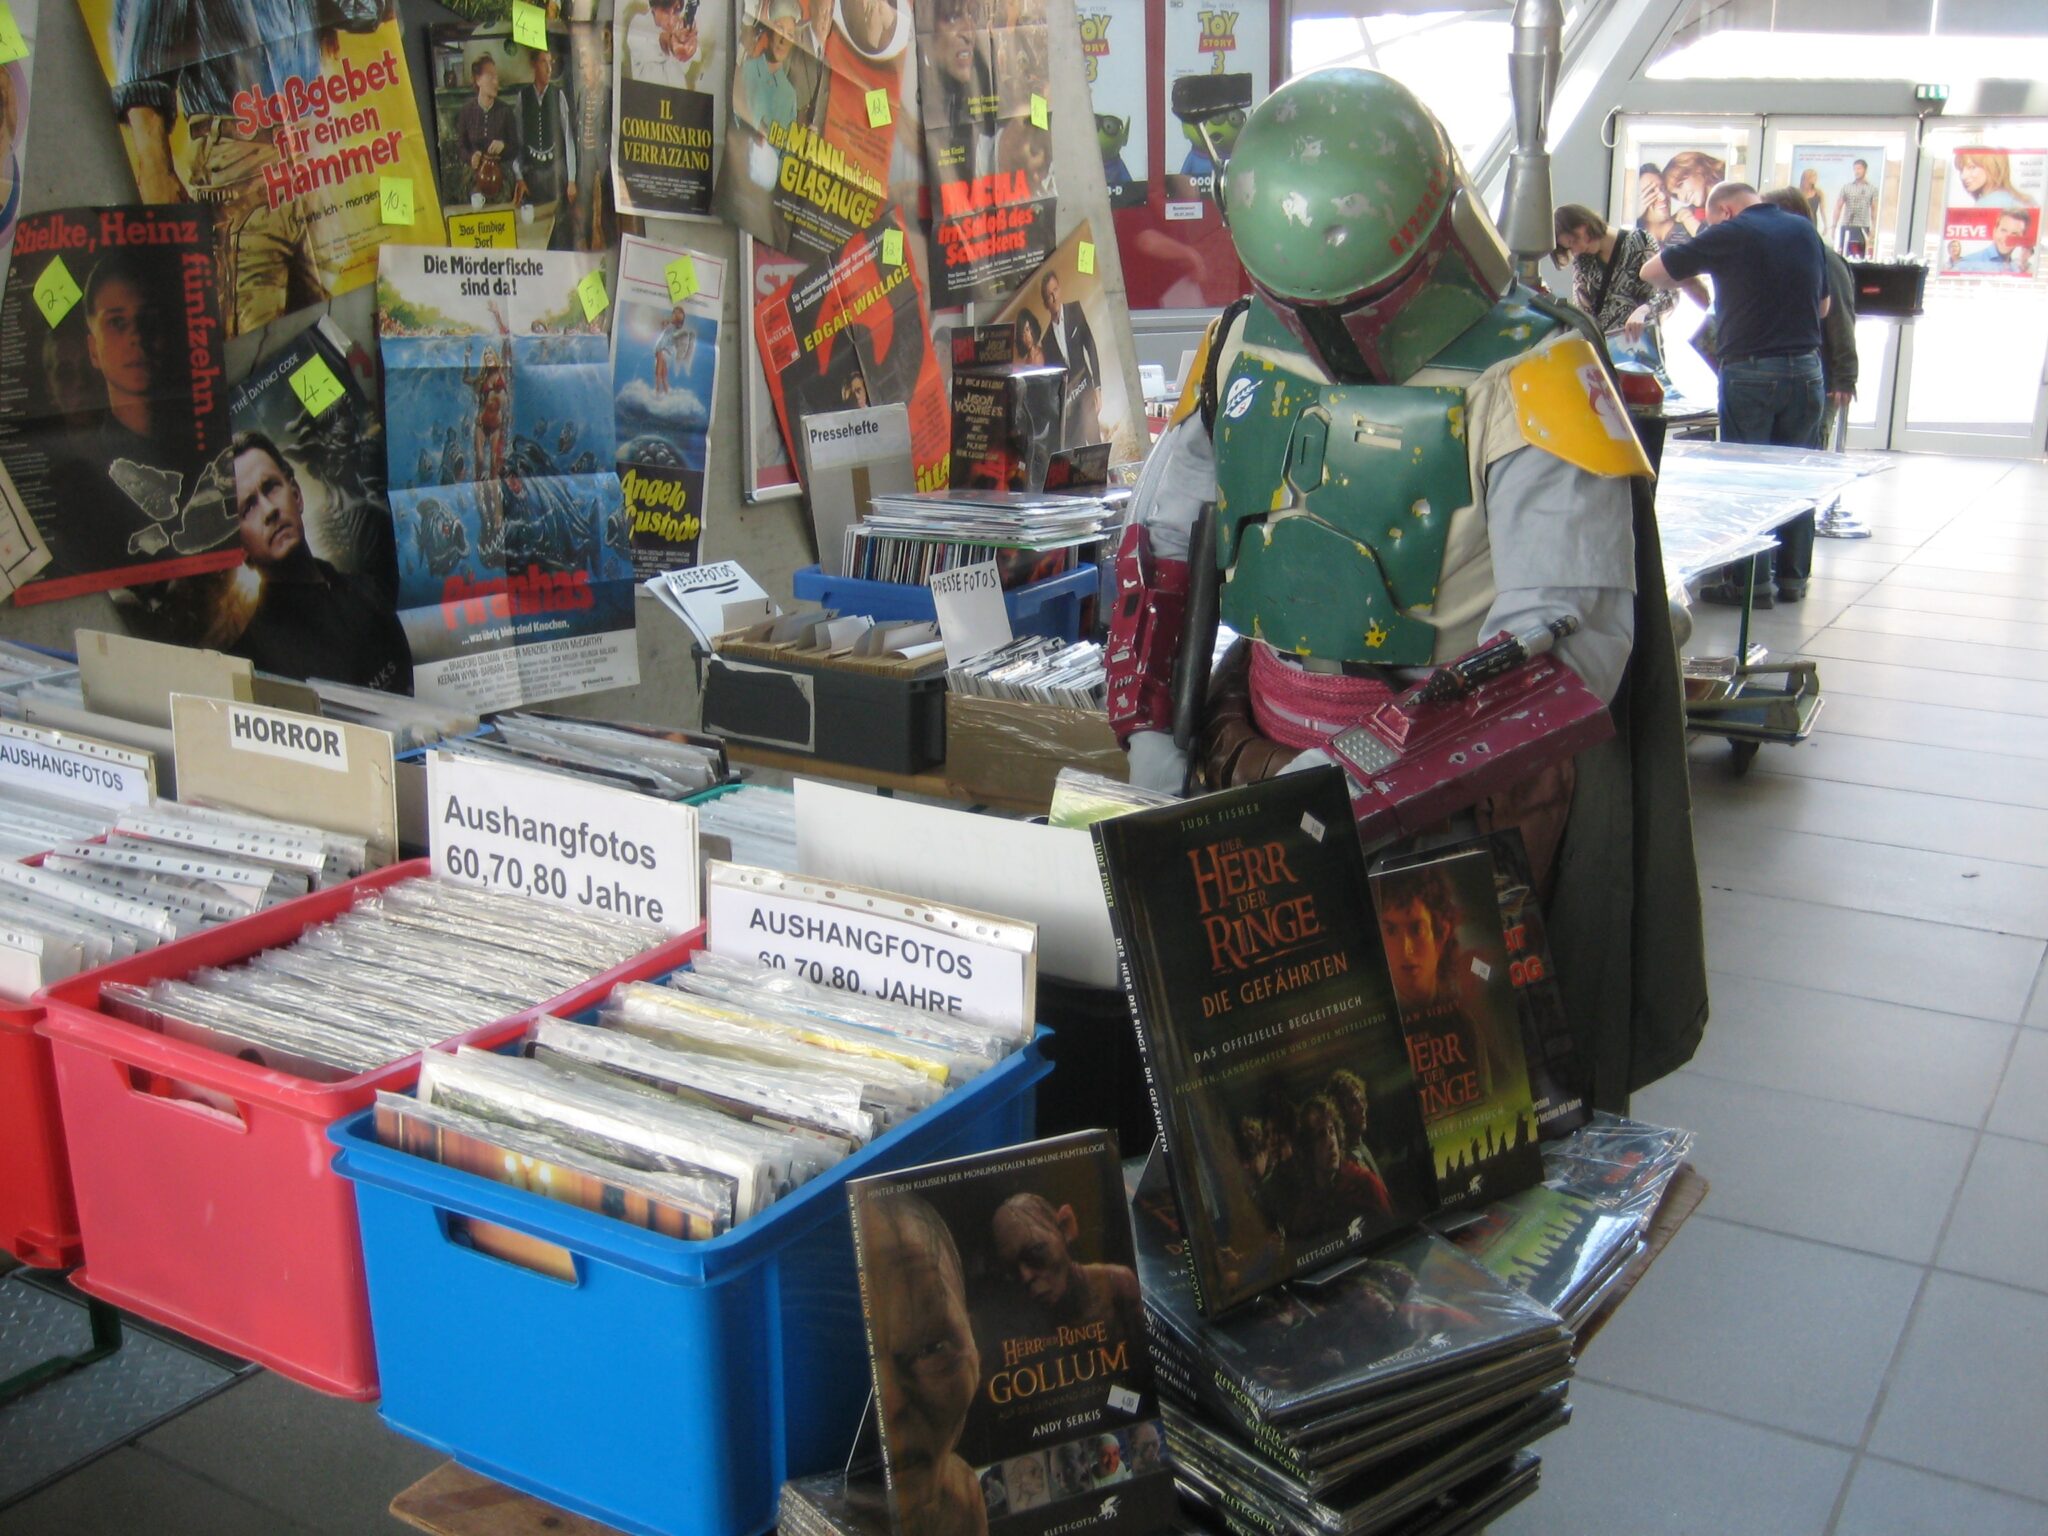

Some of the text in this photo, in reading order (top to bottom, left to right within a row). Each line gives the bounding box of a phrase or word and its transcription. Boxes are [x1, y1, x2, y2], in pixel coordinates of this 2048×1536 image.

[1197, 10, 1239, 36] TOY
[1083, 43, 1106, 53] ORY
[1202, 38, 1234, 48] STORY
[1211, 50, 1226, 75] 3
[1085, 55, 1099, 83] 3
[233, 50, 399, 135] Stoßgebet
[660, 99, 674, 120] IL
[273, 107, 381, 160] für einen
[622, 116, 712, 149] COMMISSARIO
[785, 121, 847, 181] MANN
[262, 130, 402, 210] Hammer
[623, 141, 710, 171] VERRAZZANO
[325, 190, 381, 217] ich morgen
[780, 156, 879, 229] GLASAUGE
[13, 211, 199, 257] Stielke, Heinz
[459, 223, 475, 236] Das
[1009, 208, 1034, 229] des
[1946, 225, 1987, 237] STEVE
[474, 234, 493, 248] Dorf
[424, 254, 544, 277] Die Mörderfische
[461, 277, 518, 296] sind da!
[804, 308, 853, 352] EDGAR
[853, 262, 911, 315] WALLACE
[232, 394, 249, 415] THE
[279, 352, 300, 374] CODE
[964, 392, 995, 407] JASON
[810, 421, 879, 443] Pressehefte
[621, 468, 686, 513] Angelo
[442, 563, 595, 630] Piranhas
[516, 623, 533, 634] sind
[533, 619, 570, 633] Knochen.
[551, 640, 570, 652] KEVIN
[437, 673, 460, 687] KEENAN
[233, 712, 341, 758] HORROR
[0, 743, 124, 792] AUSHANGFOTOS
[444, 795, 657, 870] Aushangfotos
[1180, 803, 1261, 832] JUDE FISHER
[1220, 837, 1244, 852] DER
[446, 845, 664, 923] 60,70,80 Jahre
[1094, 842, 1114, 908] JUDE FISHER
[1187, 841, 1299, 914] HERR
[1237, 888, 1268, 913] DER
[750, 907, 974, 980] AUSHANGFOTOS
[1202, 895, 1322, 971] RINGE
[874, 977, 963, 1016] JAHRE
[1202, 952, 1349, 1019] DIE GEFÄHRTEN
[1115, 937, 1168, 1153] DER HERR DER RINGE DIE GEFÄHRTEN
[1193, 996, 1363, 1064] DAS OFFIZIELLE BEGLEITBUCH
[1420, 1071, 1480, 1114] INGE
[1424, 1068, 1445, 1084] DER
[867, 1185, 896, 1199] HINTER
[896, 1182, 912, 1193] DEN
[948, 1171, 963, 1182] DER
[963, 1160, 1026, 1180] MONUMENTALEN
[1296, 1239, 1345, 1268] KLETT-COTTA
[1183, 1239, 1203, 1310] KLETT-COTTA
[859, 1272, 871, 1318] GOLLUM
[1002, 1335, 1043, 1368] HERR
[1057, 1321, 1107, 1348] RINGE
[989, 1341, 1129, 1405] GOLLUM
[1032, 1408, 1101, 1438] ANDY SERKIS
[1044, 1516, 1098, 1536] KLETT-COTTA
